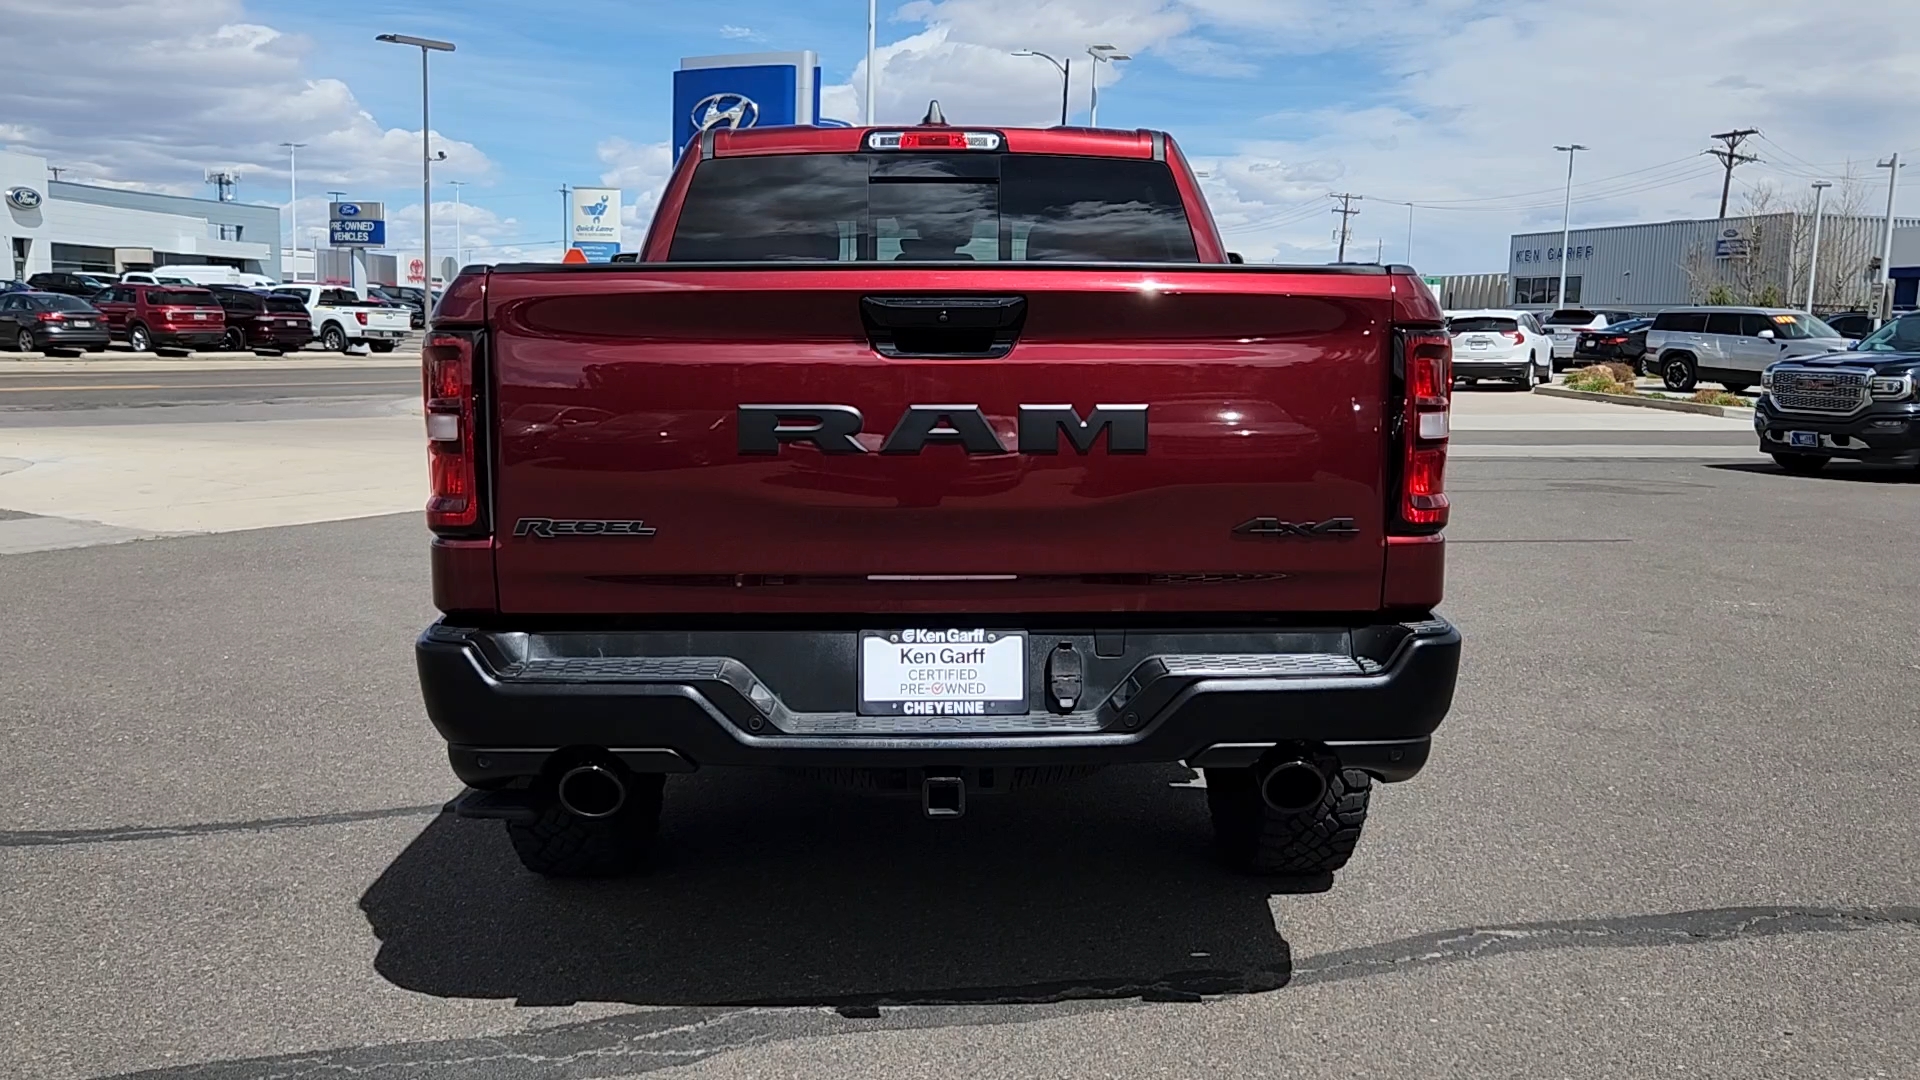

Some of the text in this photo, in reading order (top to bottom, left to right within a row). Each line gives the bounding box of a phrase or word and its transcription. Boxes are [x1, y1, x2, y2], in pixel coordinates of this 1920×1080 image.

[331, 221, 375, 231] PRE-OWNED
[576, 224, 594, 232] Quick
[333, 232, 369, 241] VEHICLES
[1515, 246, 1593, 263] KEN GARFF
[1871, 302, 1878, 315] 5
[735, 403, 1149, 456] RAM
[512, 516, 657, 538] REBEL
[916, 629, 985, 642] Ken Garff
[900, 648, 985, 664] Ken Garff
[908, 669, 977, 681] CERTIFIED
[903, 701, 985, 714] CHEYENNE
